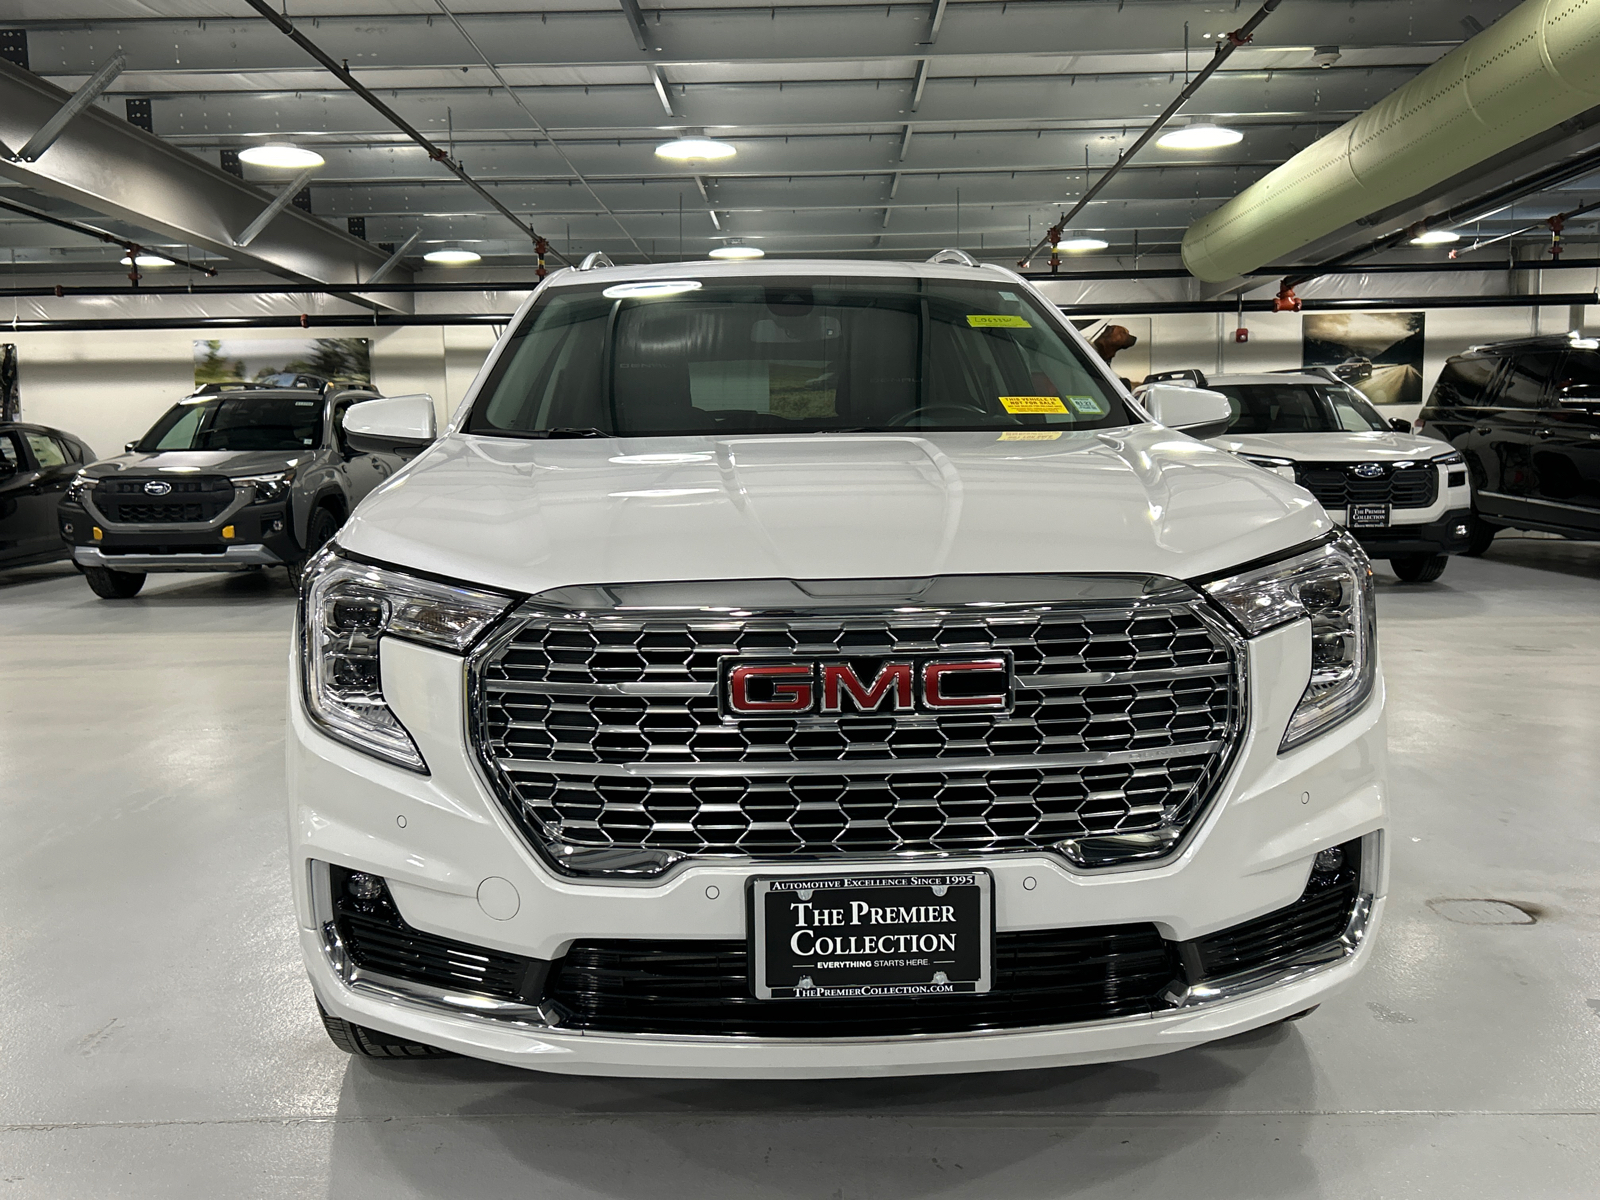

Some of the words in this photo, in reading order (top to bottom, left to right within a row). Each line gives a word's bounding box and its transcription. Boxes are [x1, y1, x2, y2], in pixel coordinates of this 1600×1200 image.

[728, 658, 1006, 713] GMC
[772, 880, 841, 891] AUTOMOTIVE
[844, 877, 908, 887] EXCELLENCE
[910, 876, 942, 886] SINCE
[945, 875, 974, 885] 1995
[790, 902, 845, 927] THE
[849, 901, 956, 925] PREMIER
[790, 929, 957, 956] COLLECTION
[817, 961, 872, 969] EVERYTHING
[873, 960, 905, 968] STARTS
[906, 958, 931, 966] HERE.
